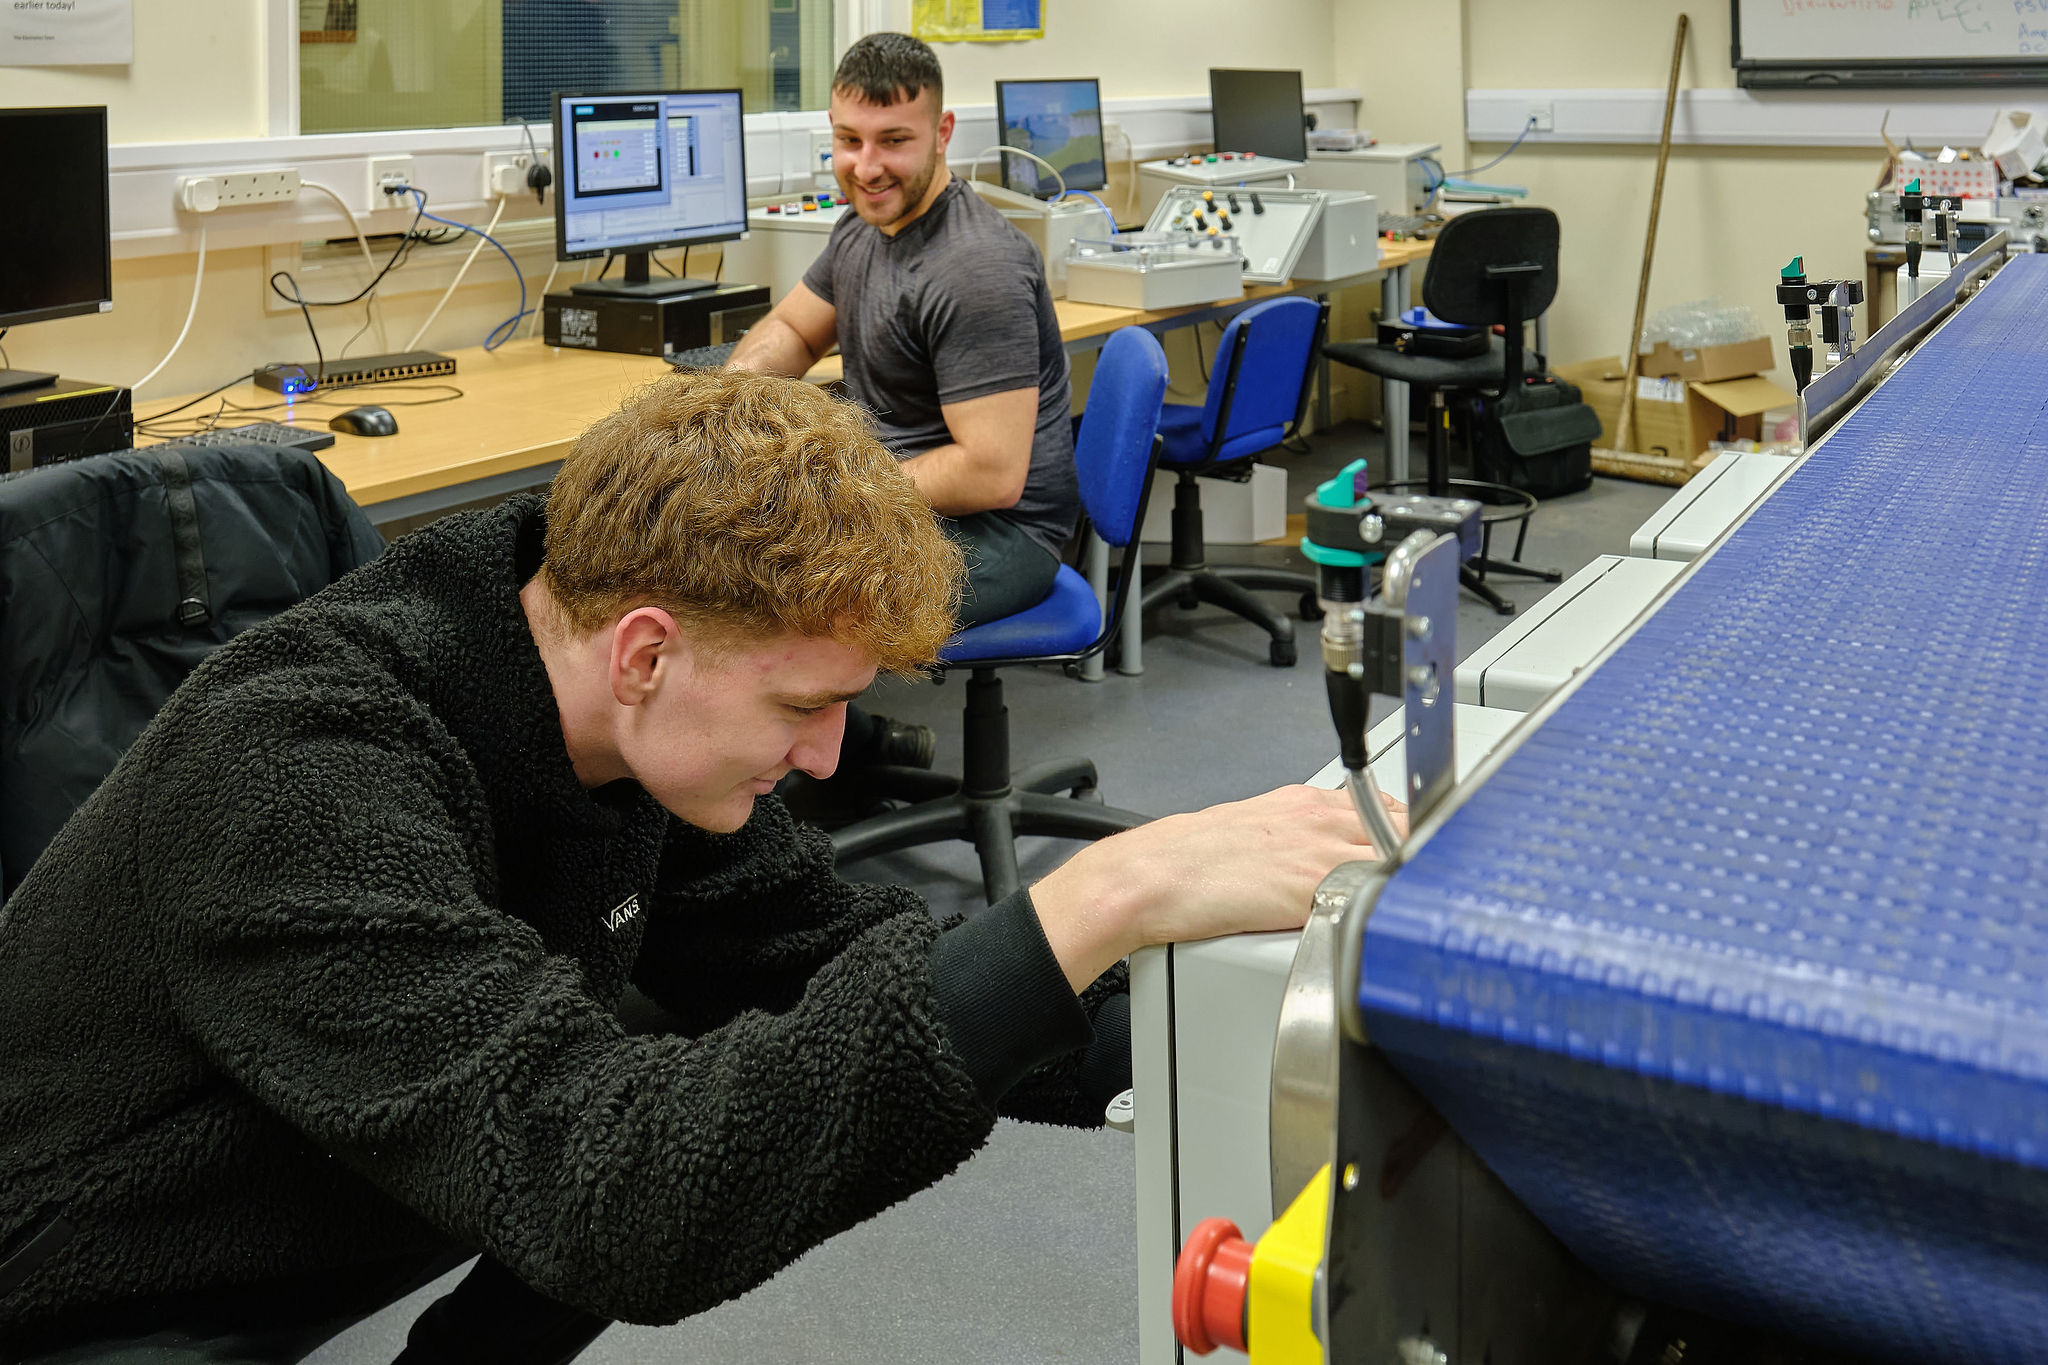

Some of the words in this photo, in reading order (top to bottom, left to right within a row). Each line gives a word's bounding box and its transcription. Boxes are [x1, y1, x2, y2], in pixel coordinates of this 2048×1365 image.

[13, 0, 44, 10] earlier
[46, 0, 75, 12] today!
[601, 892, 640, 932] VANS
